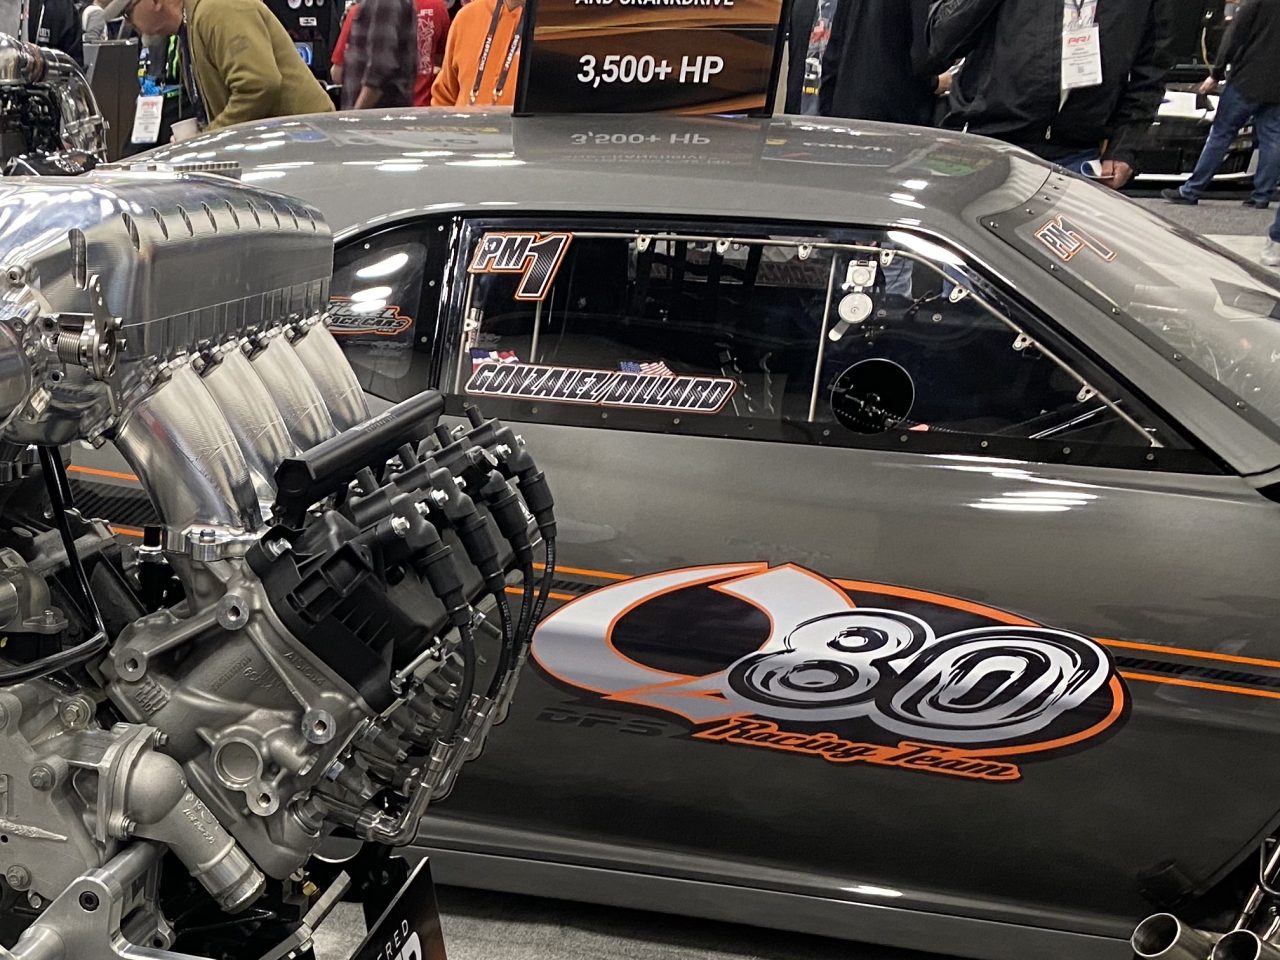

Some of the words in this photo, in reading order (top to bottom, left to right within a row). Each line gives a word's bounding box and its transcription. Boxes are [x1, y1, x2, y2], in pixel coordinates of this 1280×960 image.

[577, 54, 672, 88] 3,500+
[679, 56, 724, 83] HP
[713, 717, 877, 758] Racing
[888, 742, 1020, 780] Team
